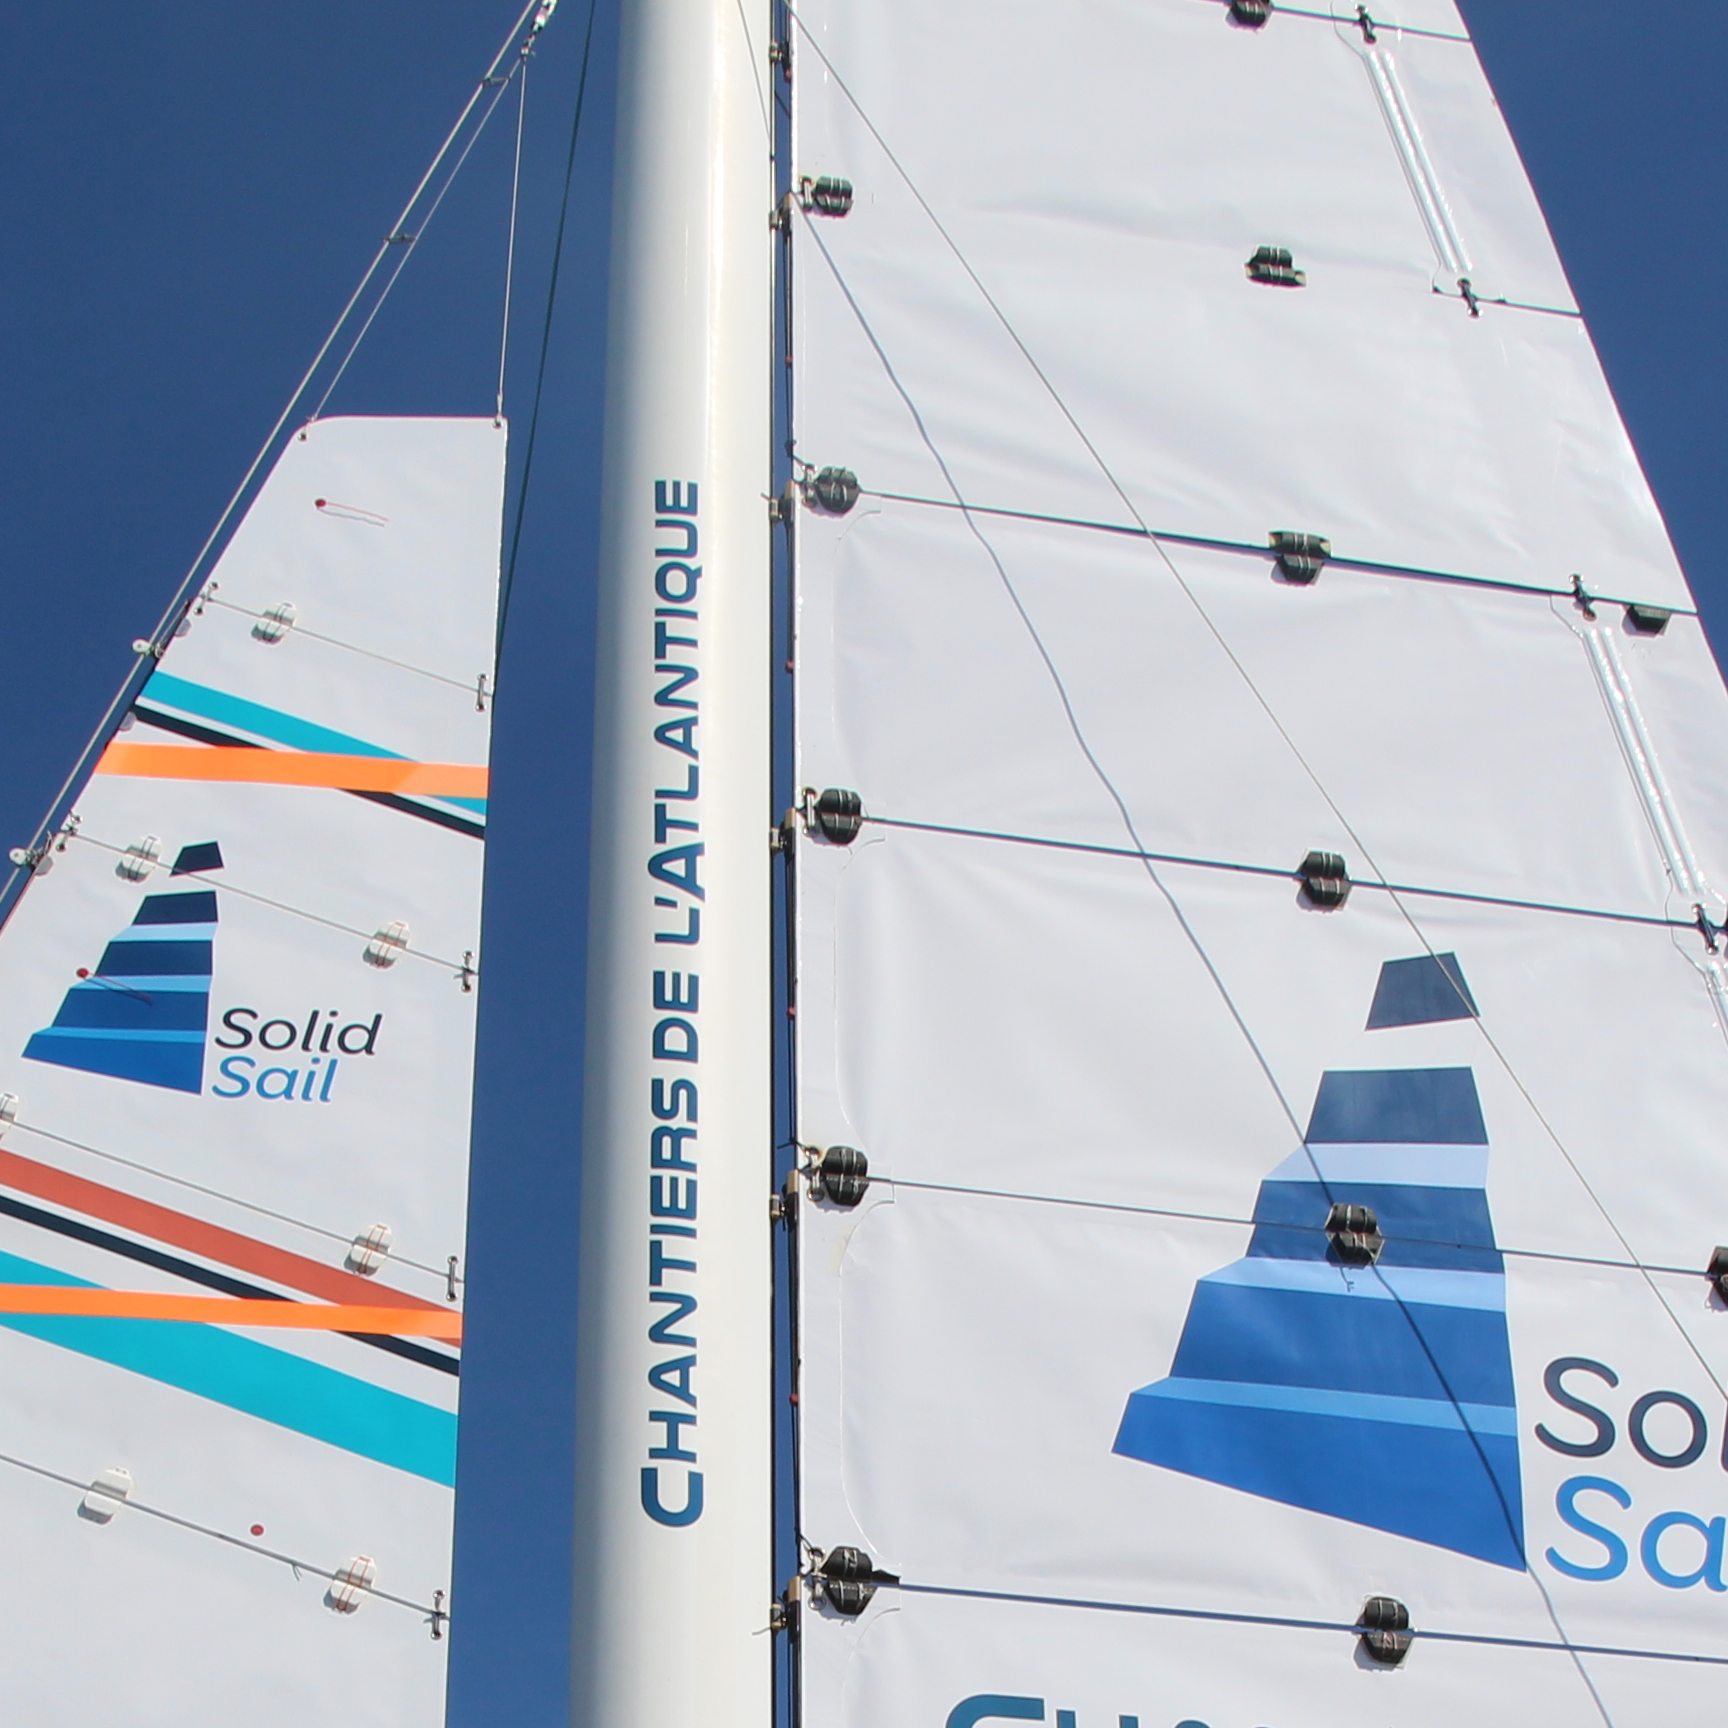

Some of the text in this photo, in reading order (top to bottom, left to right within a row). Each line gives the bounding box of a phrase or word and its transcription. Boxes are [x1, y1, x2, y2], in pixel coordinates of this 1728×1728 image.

[213, 1007, 384, 1056] Solid
[651, 969, 699, 1063] DE
[210, 1055, 340, 1103] Sail
